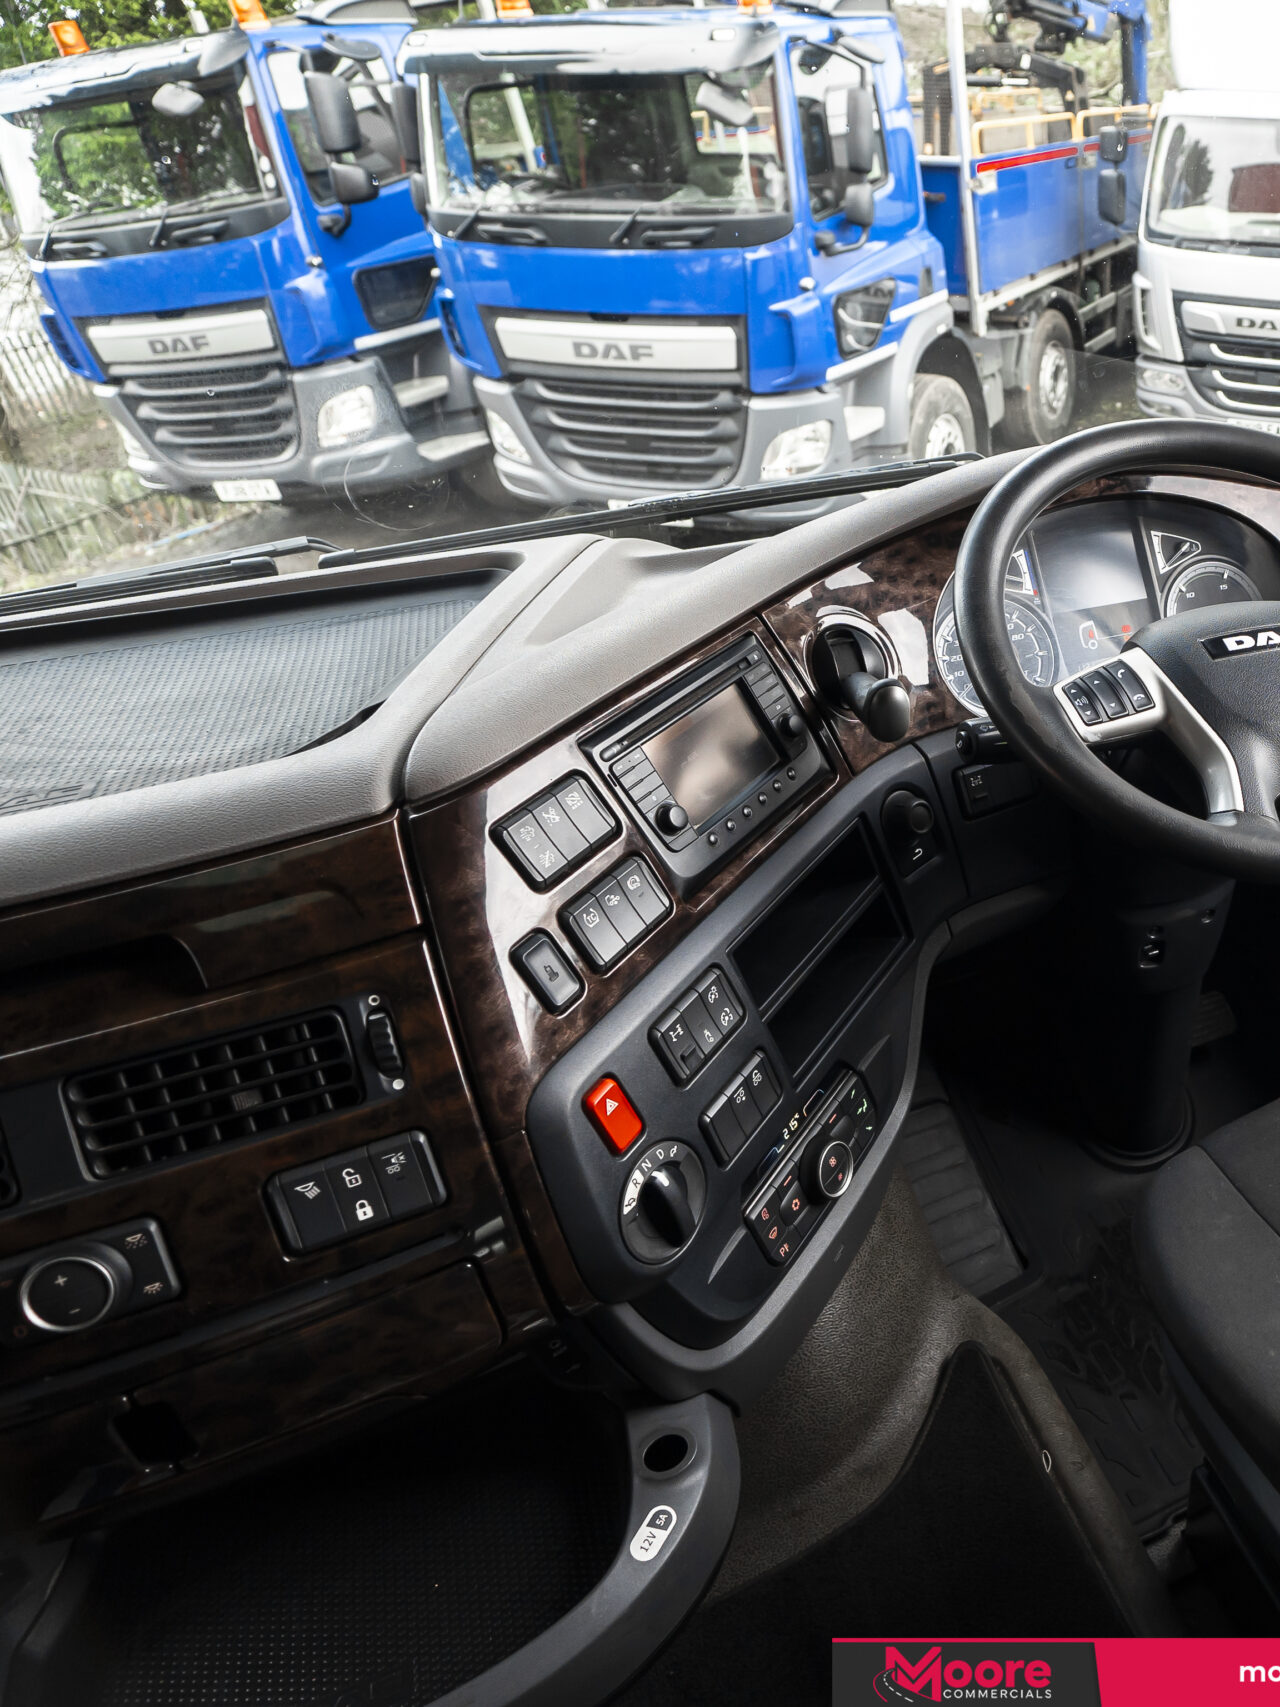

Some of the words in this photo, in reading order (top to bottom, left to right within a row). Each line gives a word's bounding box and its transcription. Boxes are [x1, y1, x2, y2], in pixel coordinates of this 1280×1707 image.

[147, 334, 209, 354] DAF
[572, 341, 653, 360] DAF
[1011, 633, 1025, 641] 80
[632, 1178, 640, 1188] R
[641, 1158, 652, 1172] N
[655, 1149, 664, 1160] D
[640, 1531, 656, 1552] 12V
[655, 1514, 669, 1526] 5A
